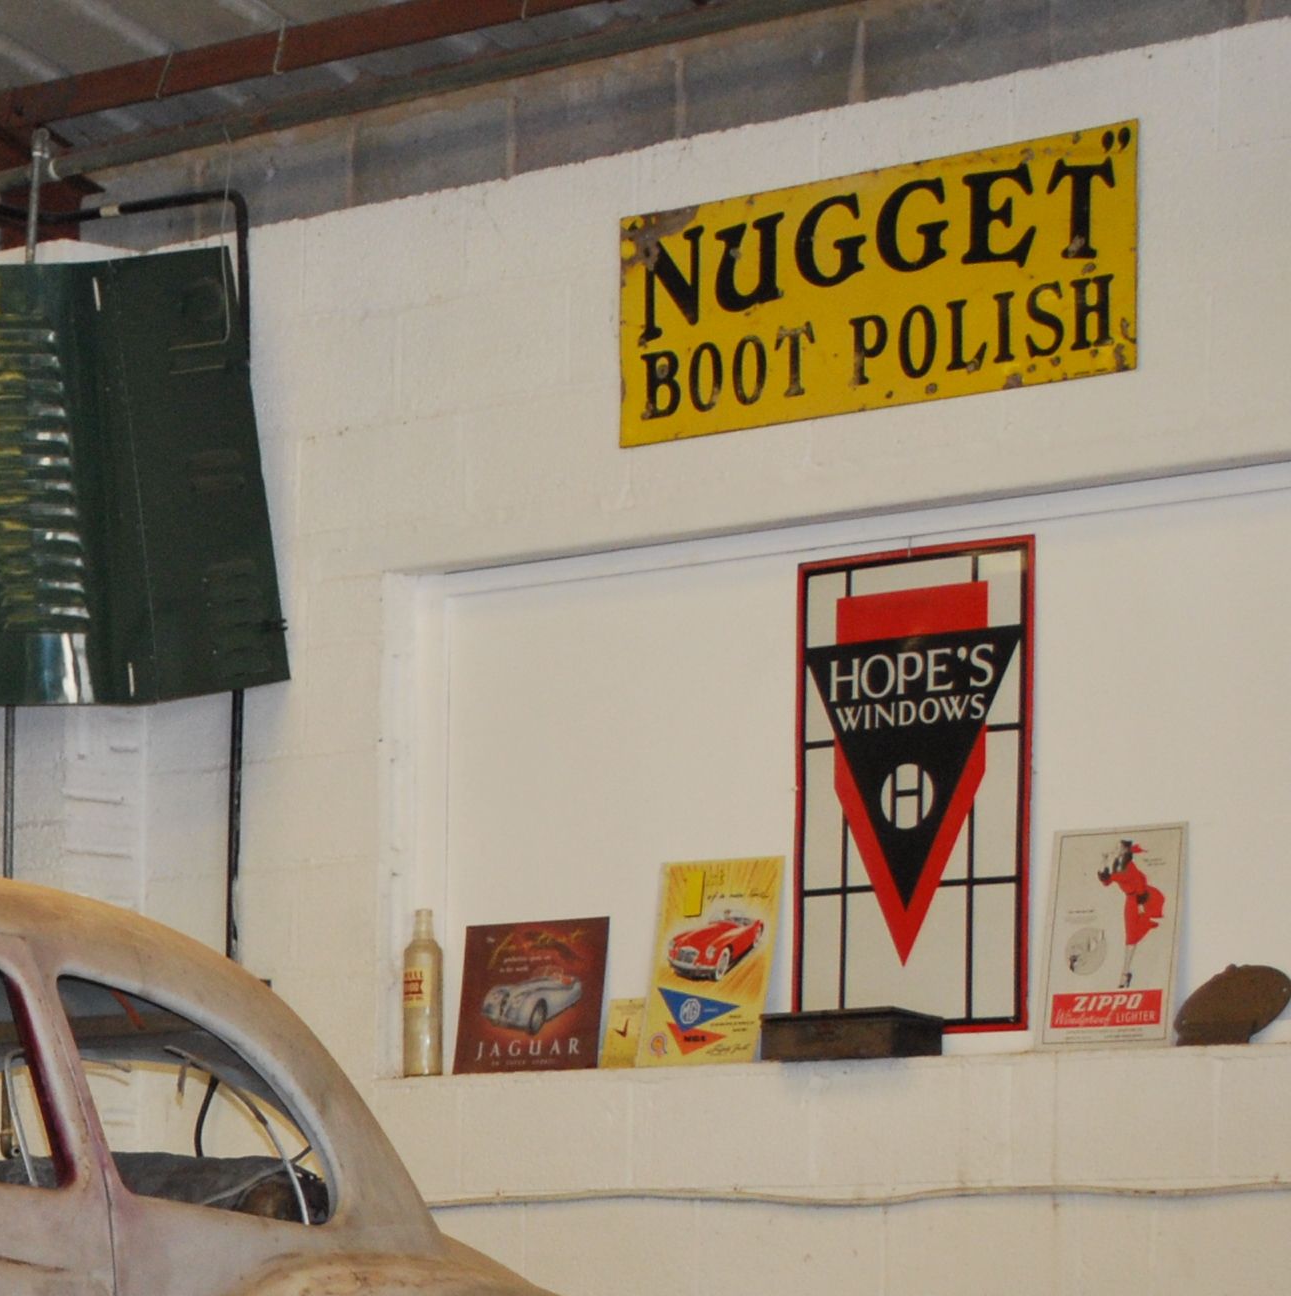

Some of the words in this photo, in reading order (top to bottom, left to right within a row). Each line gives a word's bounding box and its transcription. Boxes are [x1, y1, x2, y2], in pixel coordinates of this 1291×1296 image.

[640, 321, 816, 421] BOOT
[848, 273, 1116, 387] POLISH
[829, 643, 994, 703] HOPE'S
[835, 693, 986, 732] WINDOWS
[1072, 993, 1143, 1013] ZIPPO
[1115, 1010, 1156, 1023] LIGHTER
[476, 1036, 580, 1061] JAGUAR
